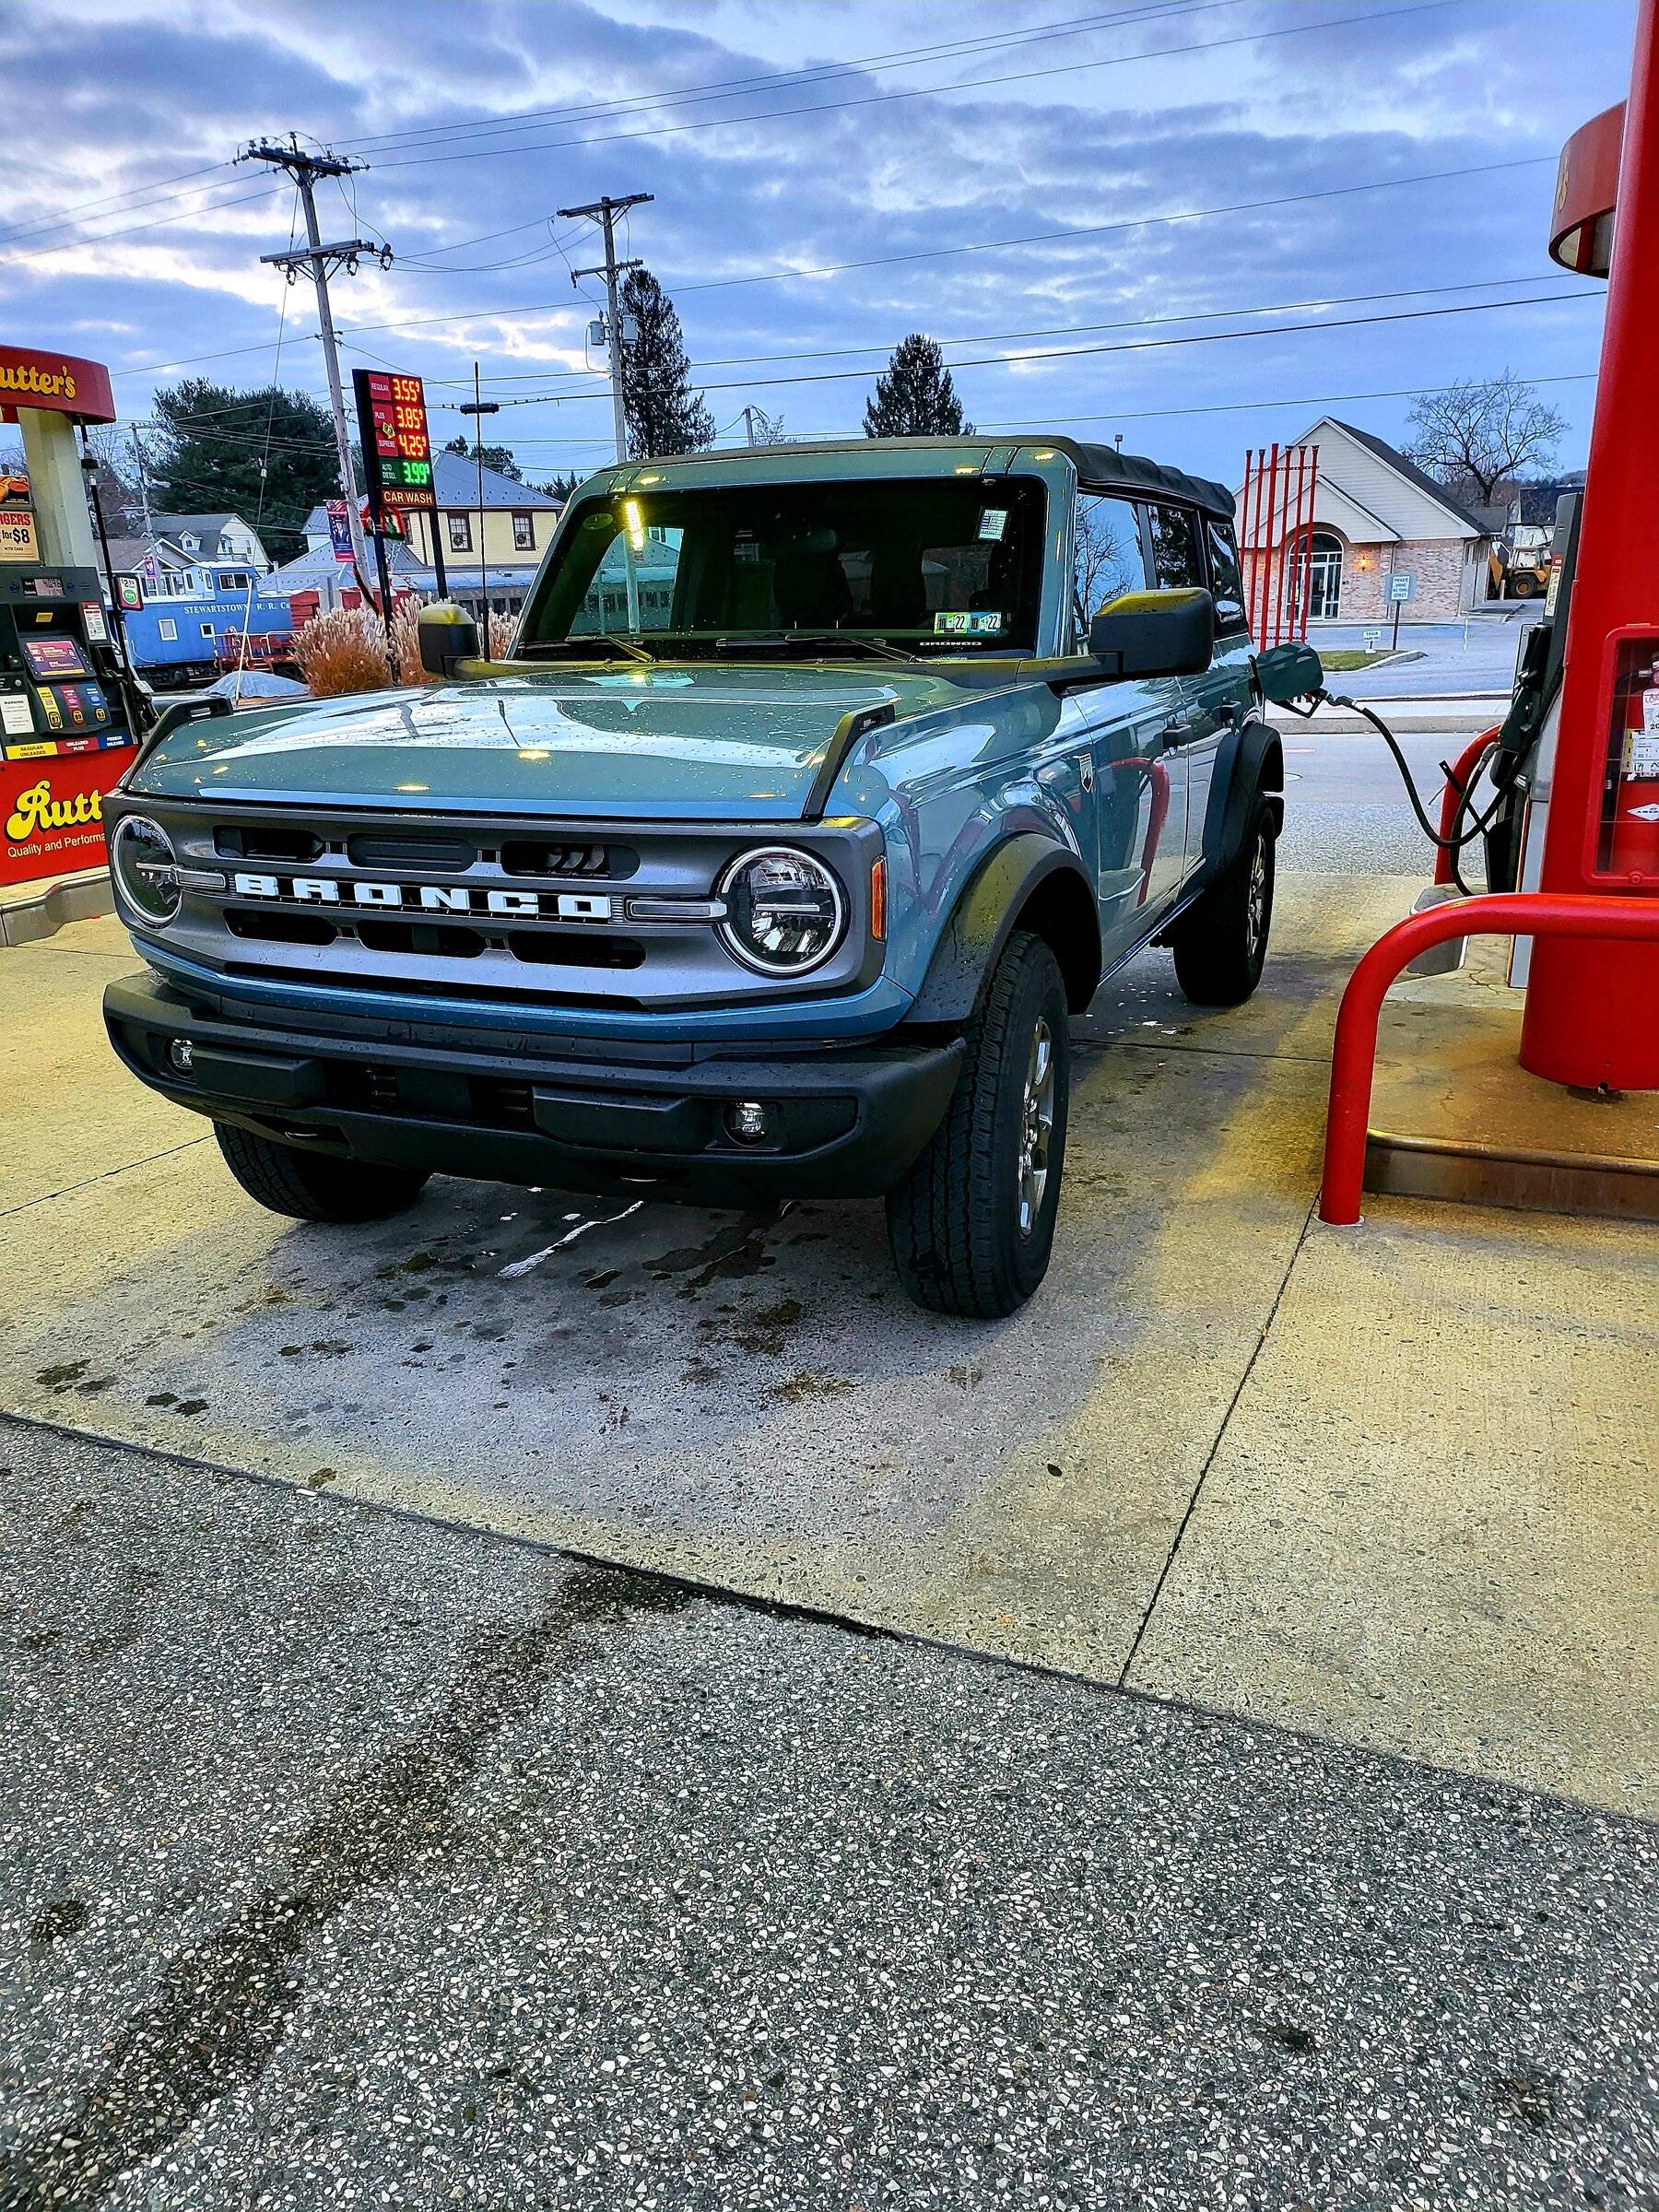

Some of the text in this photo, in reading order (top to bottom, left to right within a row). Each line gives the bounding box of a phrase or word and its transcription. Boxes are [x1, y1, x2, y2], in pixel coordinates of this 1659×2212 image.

[371, 382, 389, 391] REGULAR
[374, 411, 385, 419] PLUS
[383, 490, 433, 503] CAR WASH
[13, 527, 30, 544] $8
[184, 603, 250, 615] STEWARTSTOWN
[256, 602, 265, 611] R.
[268, 601, 277, 610] R.
[956, 616, 966, 630] 22
[988, 616, 998, 630] 22
[7, 832, 106, 858] Quality and Performa
[234, 872, 611, 919] BRONCO
